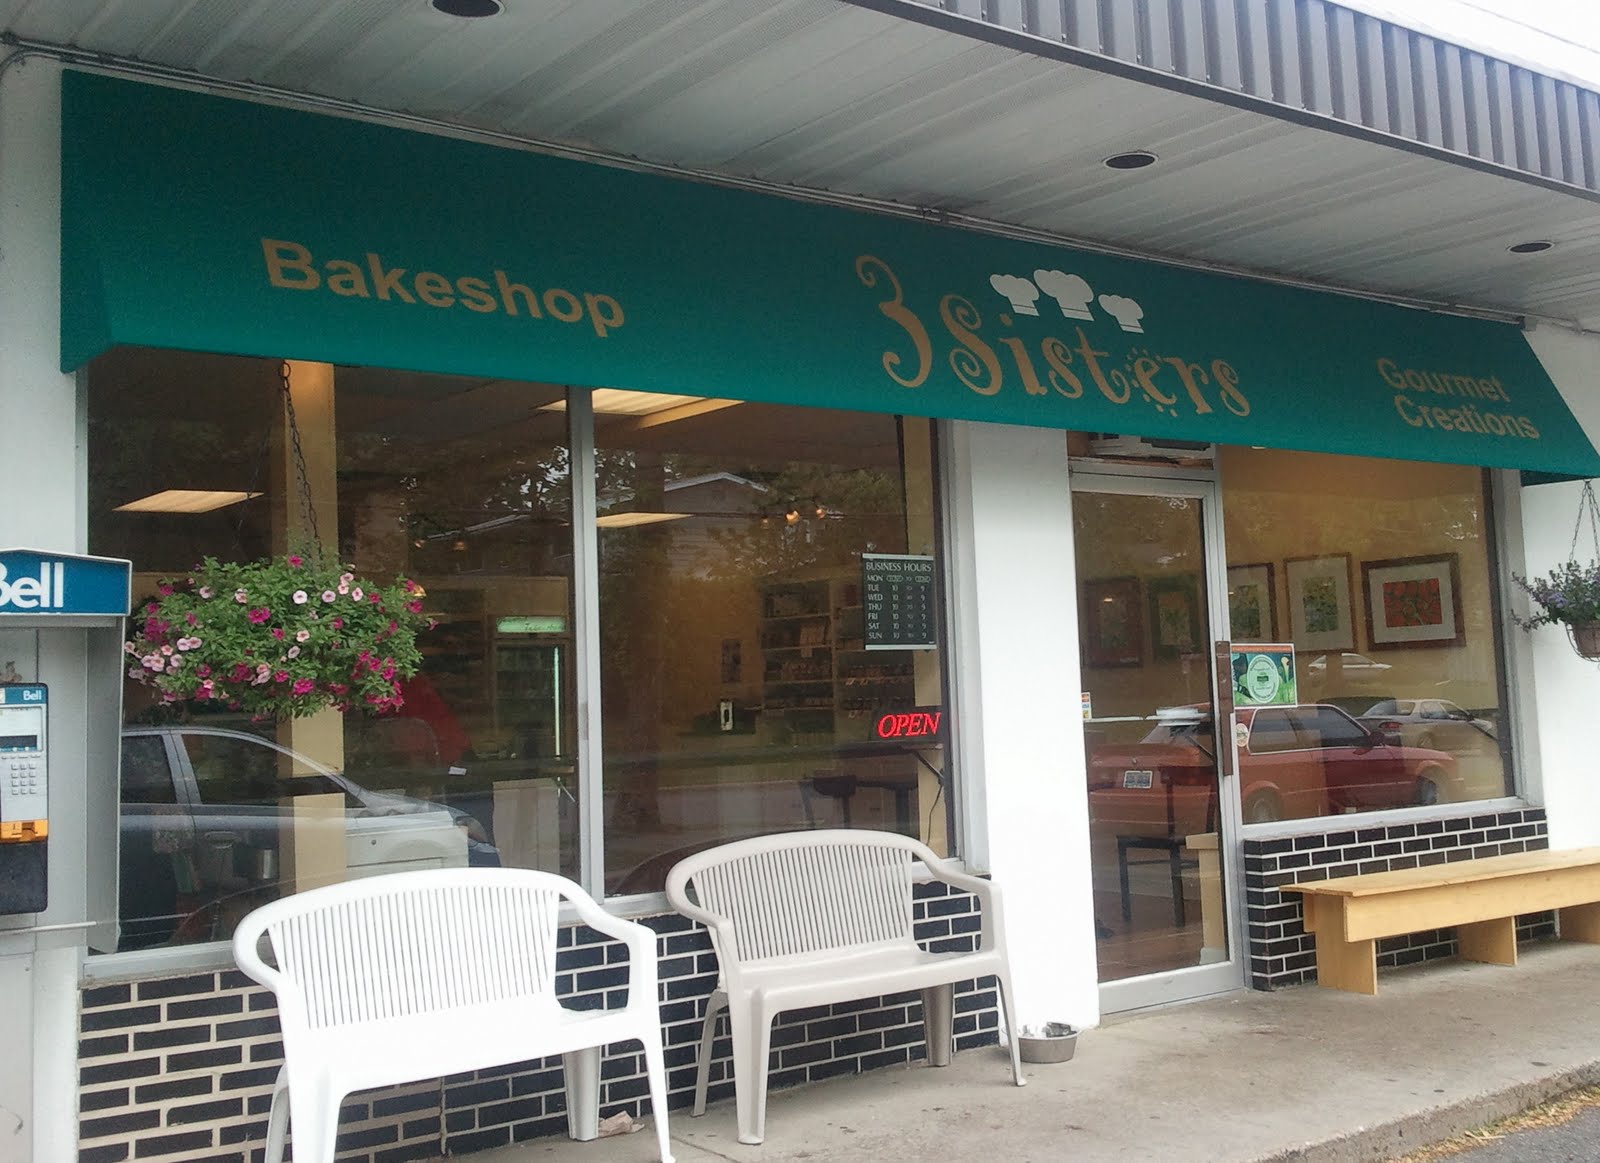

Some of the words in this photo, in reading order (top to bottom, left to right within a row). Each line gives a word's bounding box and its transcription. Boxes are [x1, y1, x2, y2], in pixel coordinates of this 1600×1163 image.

[261, 238, 625, 338] Bakeshop
[855, 254, 933, 388] 3
[939, 294, 1251, 418] Sisters
[1376, 357, 1511, 402] Gourmet
[1394, 394, 1540, 439] Creations
[866, 562, 901, 572] BUSINESS
[904, 563, 932, 572] HOURS
[23, 690, 42, 701] Bell
[877, 711, 941, 738] OPEN
